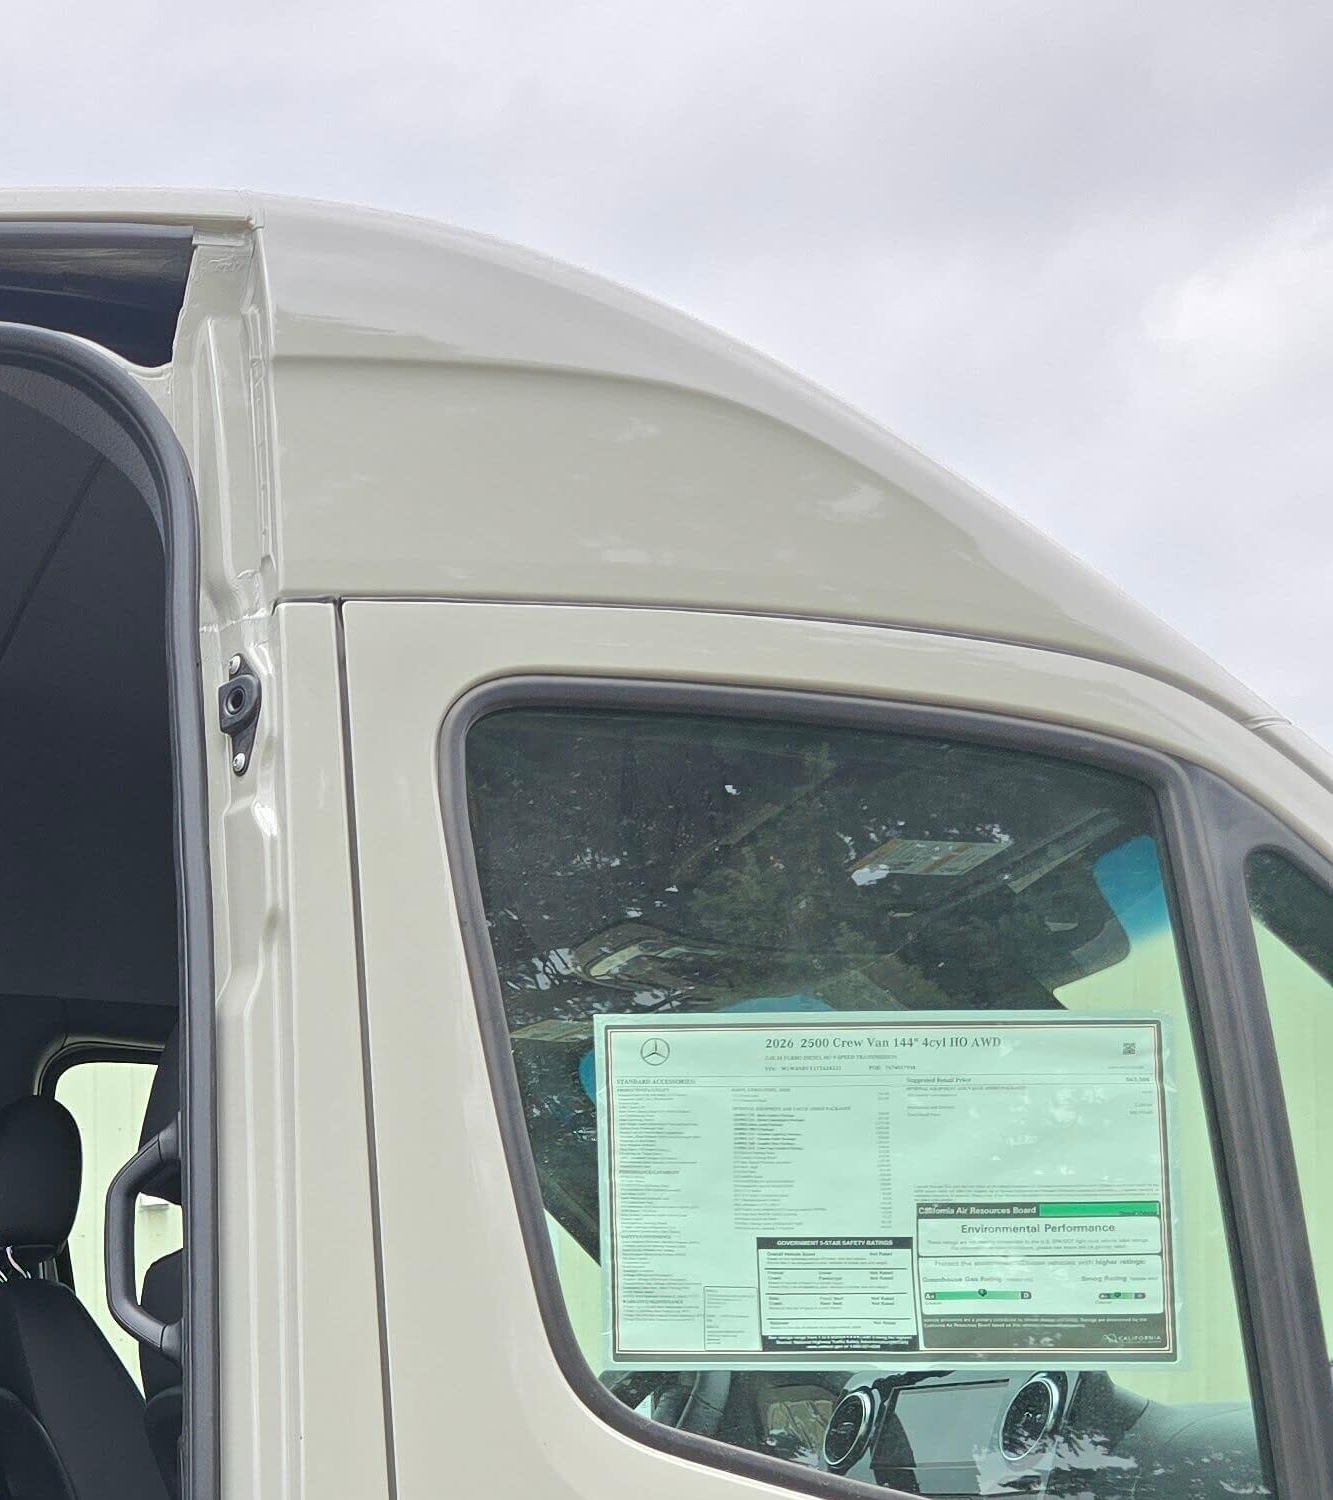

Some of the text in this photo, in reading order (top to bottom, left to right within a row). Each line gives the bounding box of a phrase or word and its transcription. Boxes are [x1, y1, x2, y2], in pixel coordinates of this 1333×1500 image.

[765, 1038, 794, 1049] 2026
[800, 1038, 830, 1048] 2500
[832, 1037, 863, 1048] Crew
[866, 1037, 890, 1048] Van
[921, 1037, 946, 1050] 4cyl
[971, 1036, 1002, 1048] AWD
[956, 1206, 968, 1214] Air
[970, 1206, 1011, 1214] Resources
[1013, 1206, 1036, 1214] Board
[961, 1223, 1116, 1234] Environmental Performance
